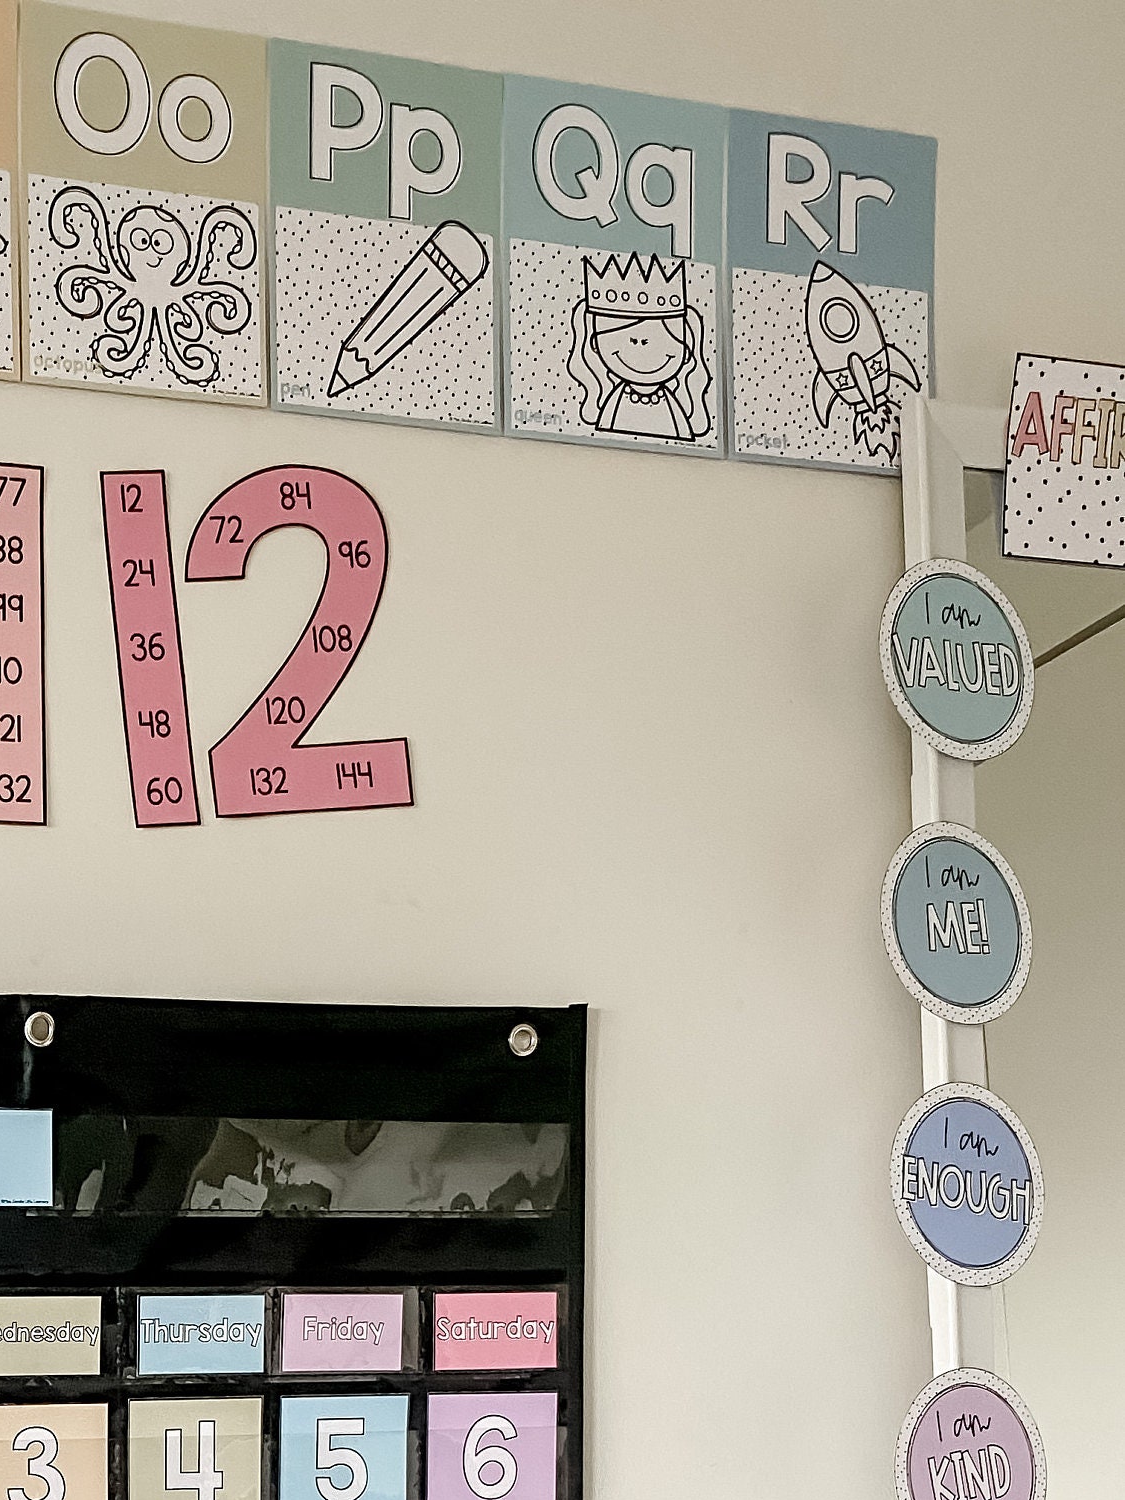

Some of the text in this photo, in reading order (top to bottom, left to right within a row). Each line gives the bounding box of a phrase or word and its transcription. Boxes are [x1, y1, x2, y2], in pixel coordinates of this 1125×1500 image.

[54, 31, 232, 164] Oo
[309, 61, 462, 219] Pp
[532, 103, 693, 259] Qq
[766, 132, 896, 255] Rr
[120, 484, 144, 512] 12
[280, 482, 312, 510] 84
[209, 516, 244, 543] 72
[338, 540, 371, 568] 96
[124, 559, 155, 586] 24
[925, 592, 981, 629] I am
[130, 632, 166, 661] 36
[313, 625, 353, 653] 108
[892, 632, 1020, 697] VALUED
[138, 710, 171, 738] 48
[266, 697, 305, 725] 120
[147, 777, 183, 805] 60
[251, 761, 373, 795] 132 144
[925, 855, 980, 890] I am
[926, 898, 991, 954] ME!
[944, 1117, 999, 1158] I am
[902, 1154, 1031, 1226] ENOUGH
[140, 1318, 262, 1346] Thursday
[302, 1315, 385, 1345] Friday
[436, 1314, 555, 1344] Saturday
[936, 1411, 992, 1442] I am
[462, 1414, 518, 1499] 6
